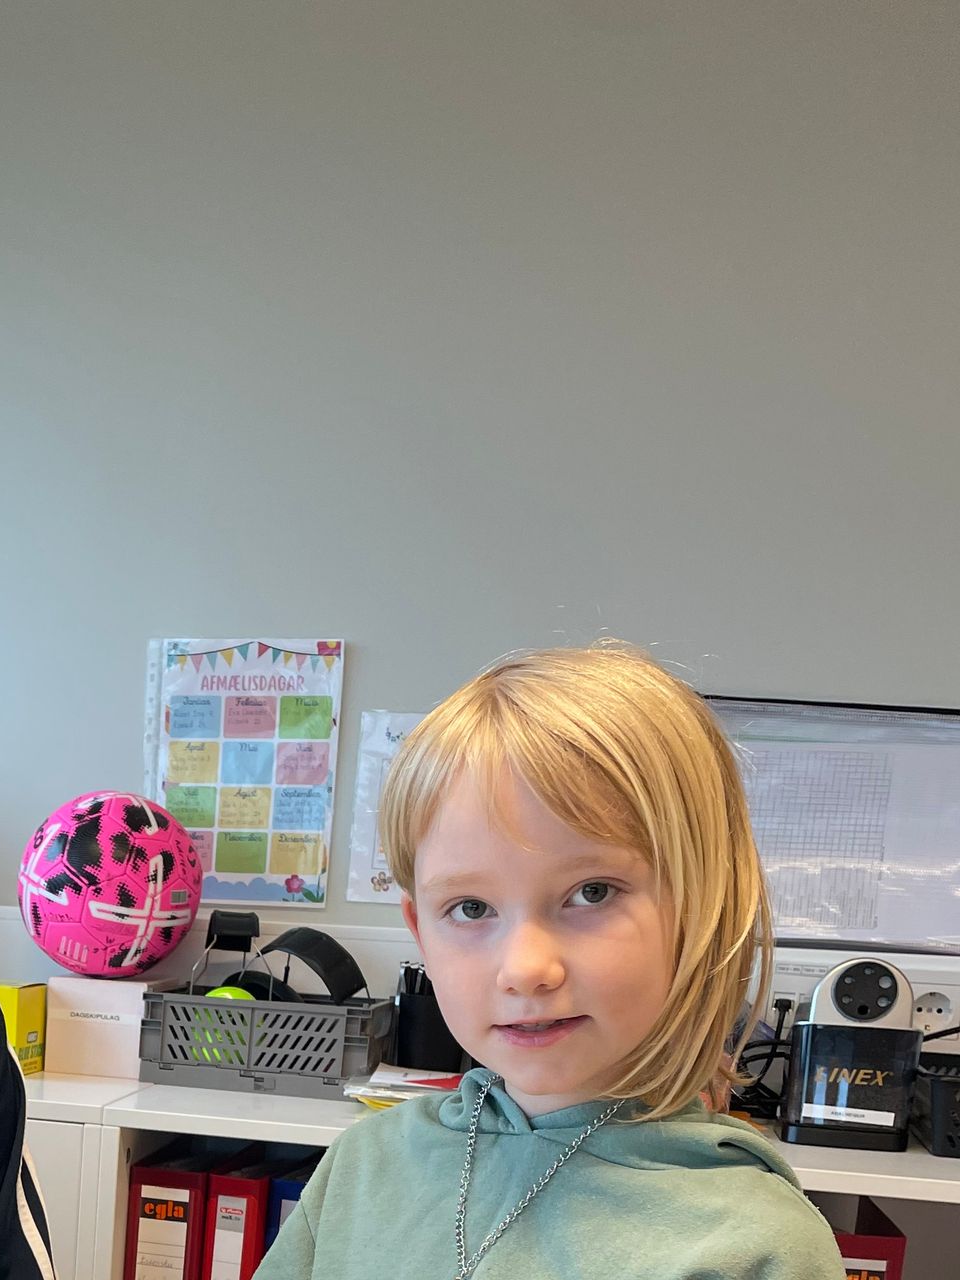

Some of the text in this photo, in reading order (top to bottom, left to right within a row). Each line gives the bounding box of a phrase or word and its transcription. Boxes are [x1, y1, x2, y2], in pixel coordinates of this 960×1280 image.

[200, 674, 305, 692] AFMÆLISDAGAR
[70, 1011, 120, 1021] DAGSKIPULAG
[814, 1066, 888, 1087] LINEX
[144, 1200, 184, 1219] egla
